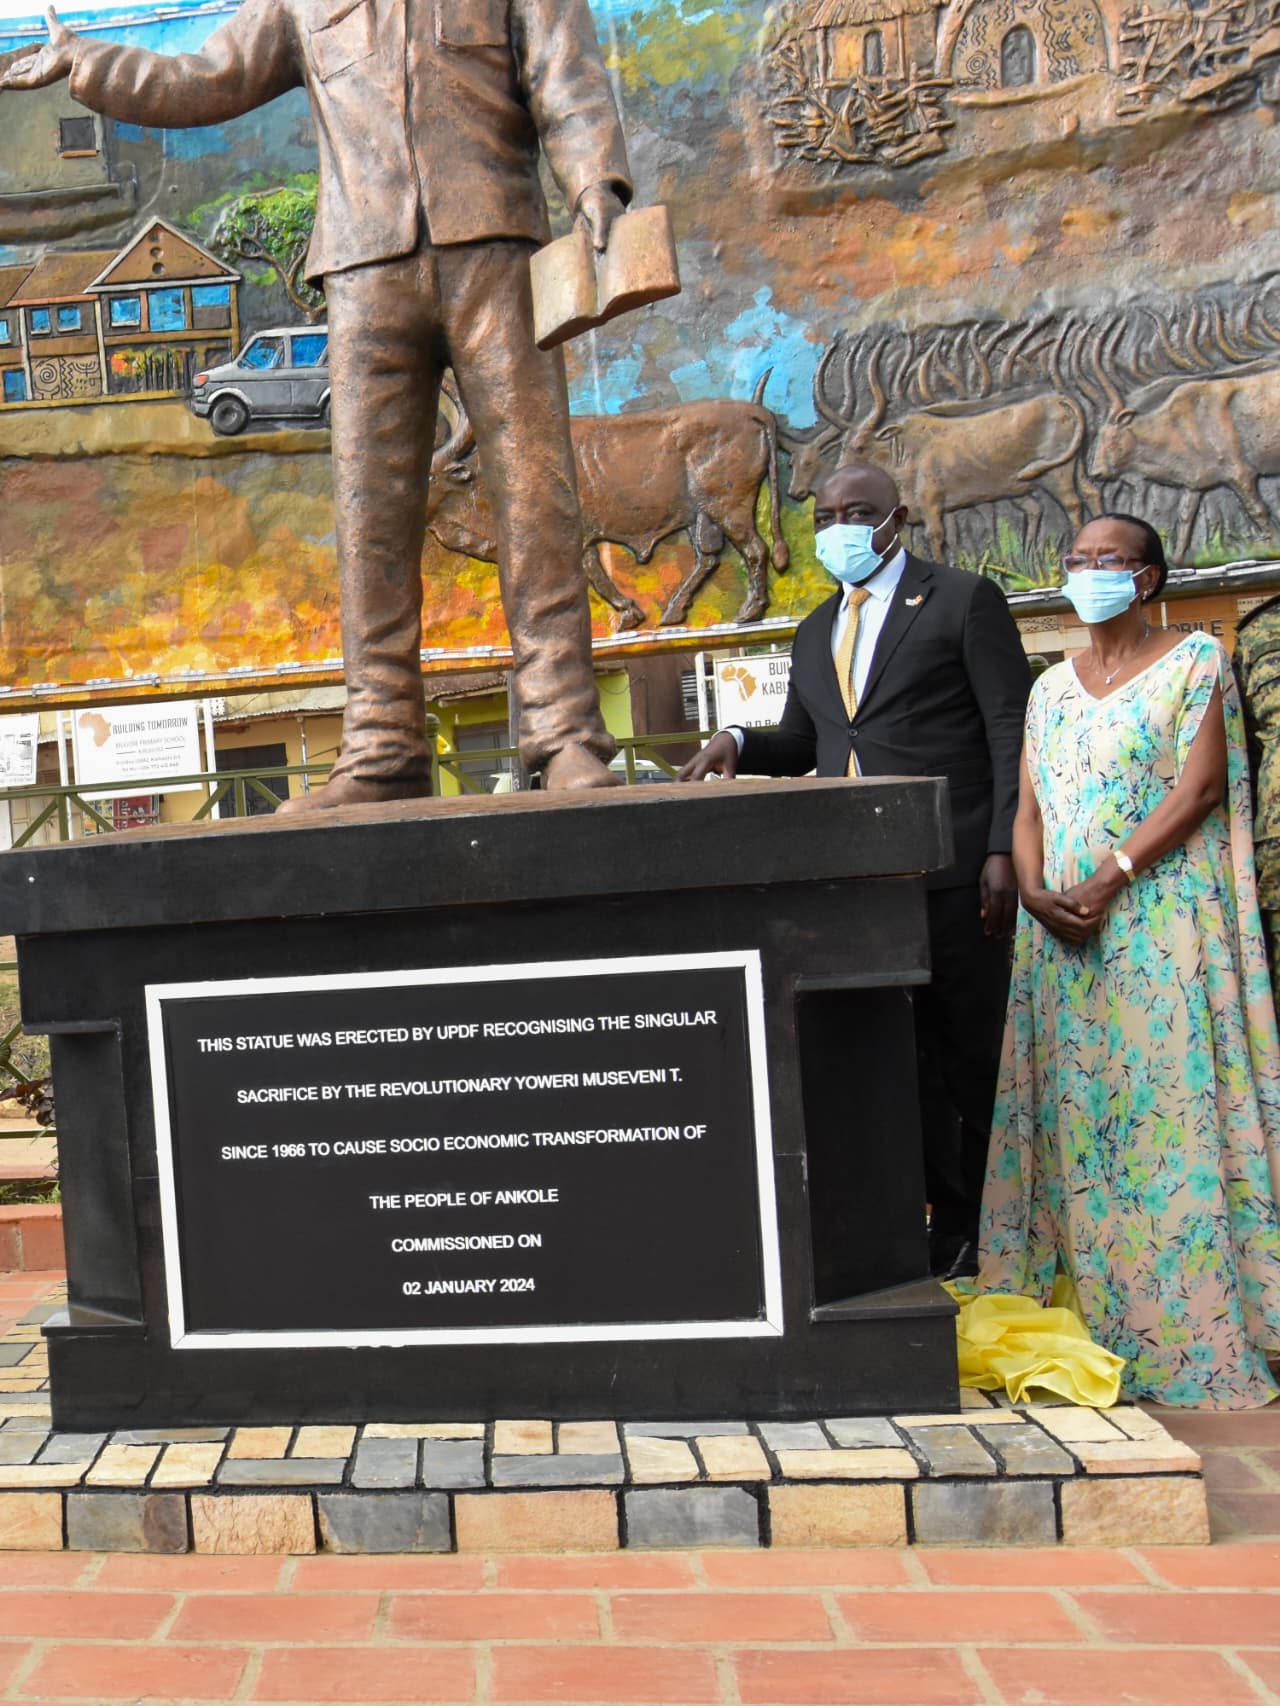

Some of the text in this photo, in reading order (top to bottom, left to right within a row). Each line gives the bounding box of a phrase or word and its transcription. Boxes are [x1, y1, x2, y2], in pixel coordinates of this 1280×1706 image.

[113, 717, 188, 735] BUILDING TOMORROW
[197, 1010, 718, 1053] THIS STATUE WAS ERECTED BY UPDF RECOGNISING THE SINGULAR
[236, 1068, 683, 1104] SACRIFICE BY THE REVOLUTIONARY YOWERI MUSEVENI T.
[221, 1125, 707, 1160] SINCE 1966 TO CAUSE SOCIO ECONOMIC TRANSFORMATION OF
[369, 1189, 560, 1209] THE PEOPLE OF ANKOLE
[391, 1234, 542, 1253] COMMISSIONED ON
[403, 1278, 536, 1296] 02 JANUARY 2024
